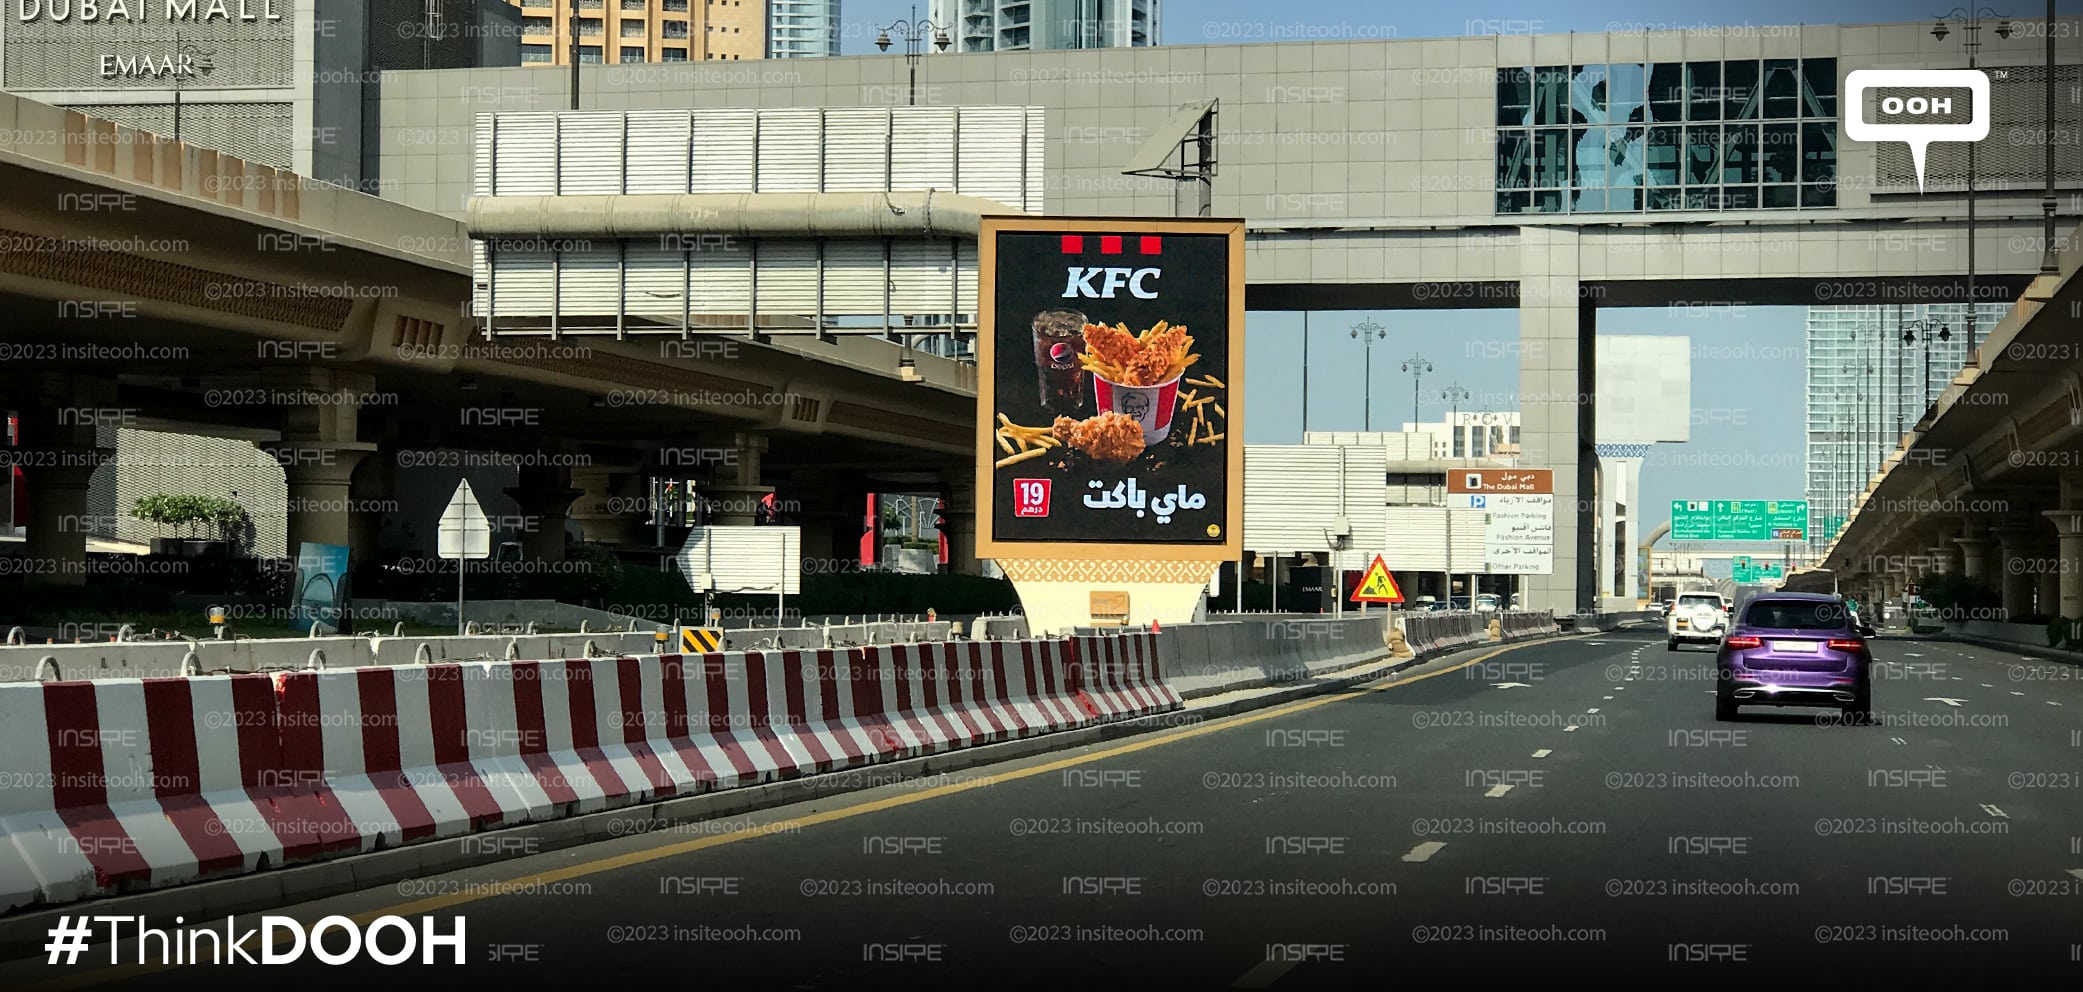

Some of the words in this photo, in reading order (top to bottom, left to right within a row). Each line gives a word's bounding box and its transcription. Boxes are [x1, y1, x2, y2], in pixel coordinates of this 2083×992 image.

[19, 0, 145, 21] DUBAI
[166, 0, 281, 20] MALL
[100, 54, 193, 76] EMAAR
[1061, 266, 1162, 299] KFC
[1501, 472, 1517, 481] مول
[1020, 482, 1044, 506] 19
[1083, 477, 1146, 518] باكت
[1151, 484, 1206, 525] ماي
[1020, 506, 1043, 516] درهم
